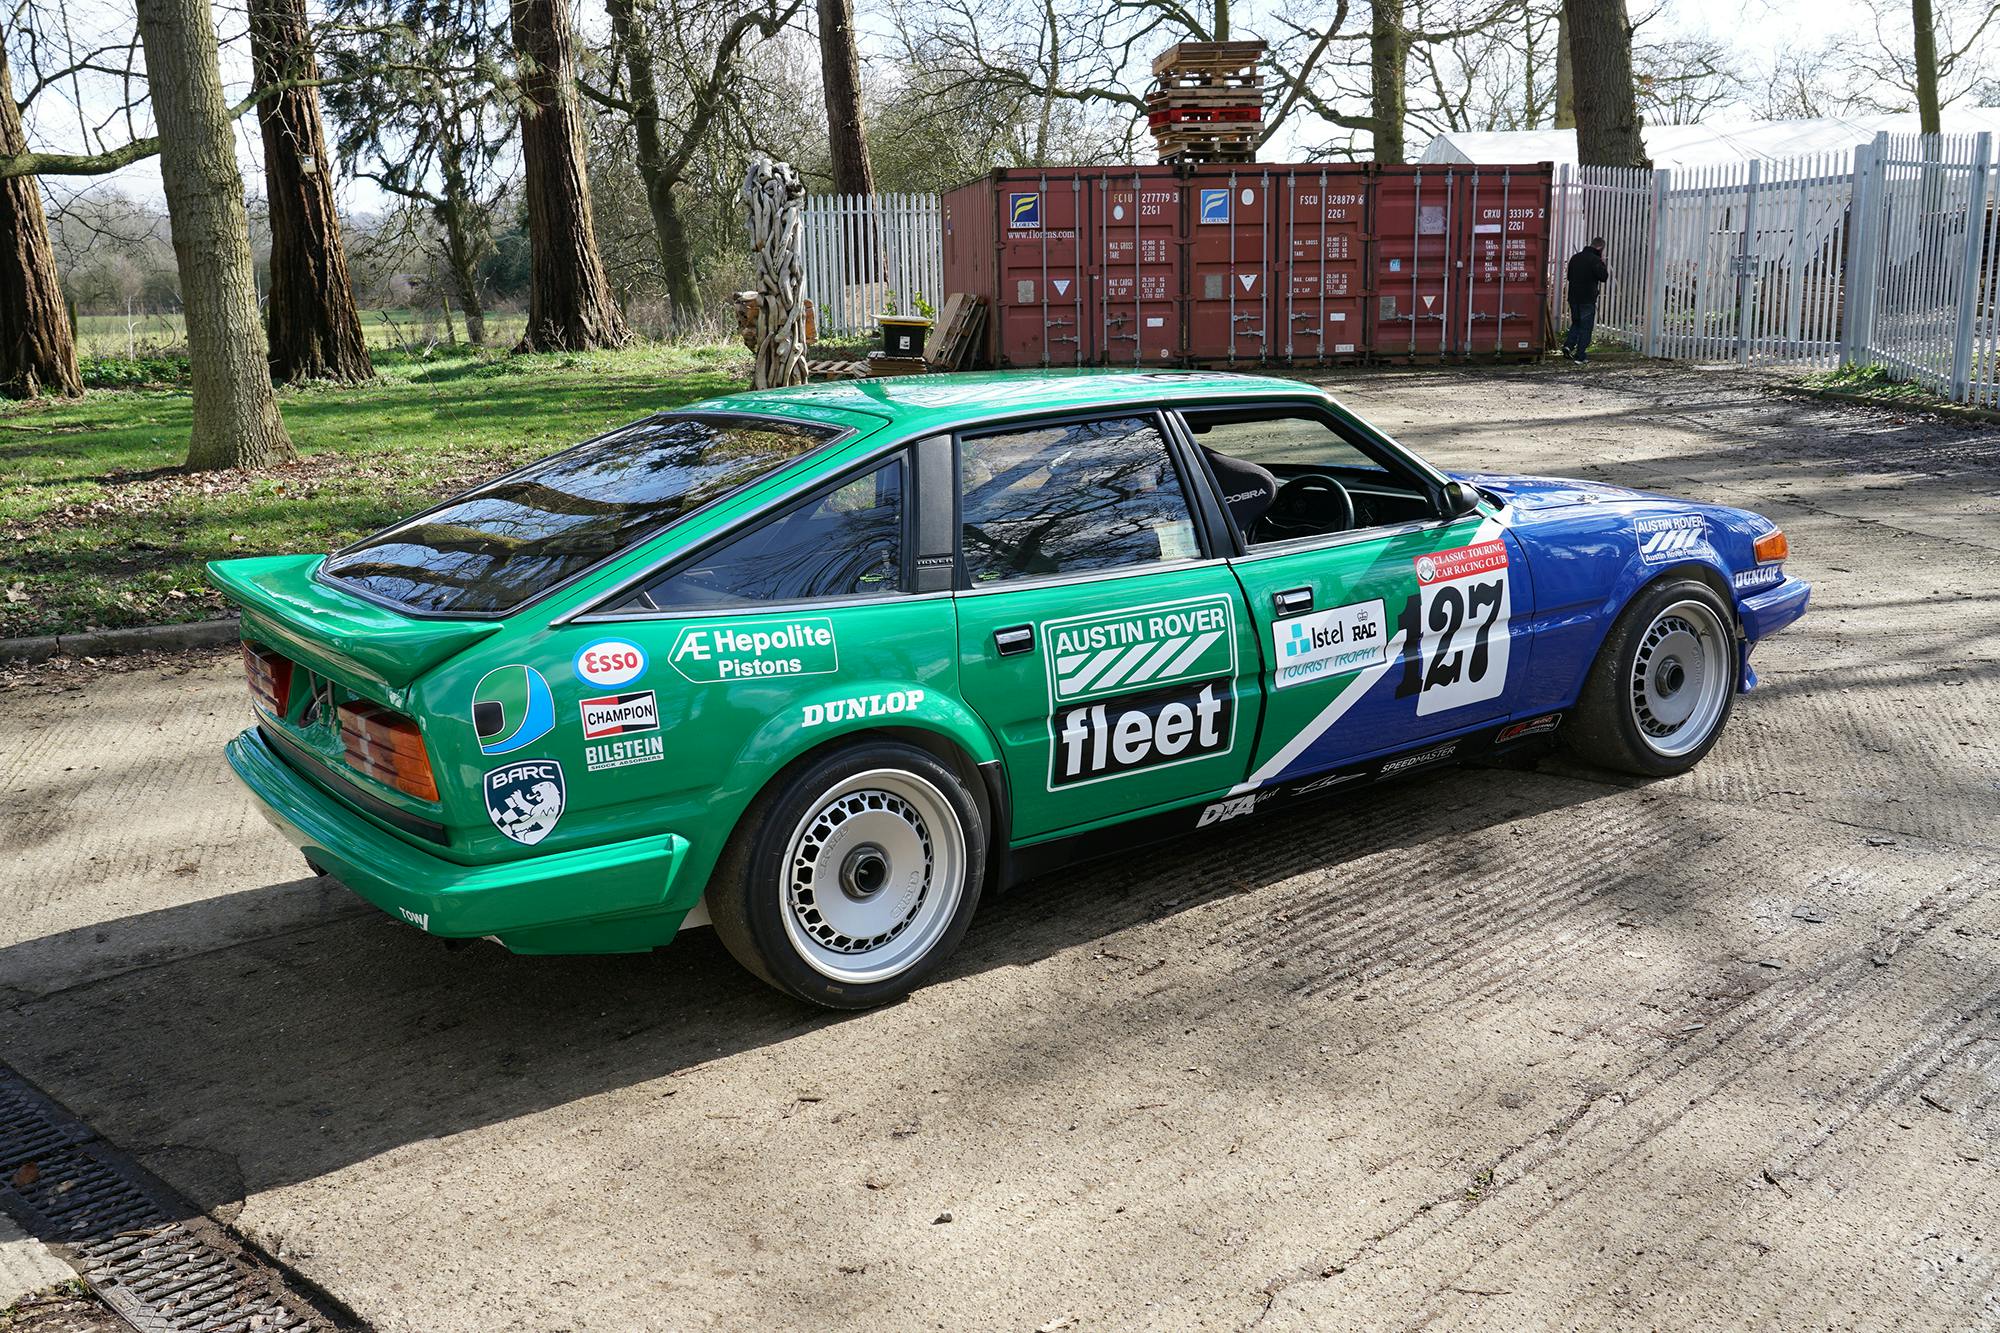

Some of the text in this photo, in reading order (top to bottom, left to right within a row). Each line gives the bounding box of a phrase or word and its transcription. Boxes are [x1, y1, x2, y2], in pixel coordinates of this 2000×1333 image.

[1141, 192, 1171, 203] 277779
[1299, 194, 1318, 205] FSCU
[1327, 194, 1356, 205] 328879
[1141, 205, 1161, 215] 22G1
[1483, 208, 1545, 219] CRXU 333195 2
[1508, 220, 1525, 231] 22G1
[1224, 488, 1267, 504] COBRA
[1638, 516, 1704, 533] AUSTIN ROVER
[1433, 542, 1504, 566] CLASSIC TOURING
[1436, 554, 1507, 579] CAR RACING CLUB
[713, 624, 832, 657] Hepolite
[1056, 607, 1226, 655] AUSTIN ROVER
[1311, 620, 1377, 650] Istel RAC
[718, 658, 802, 678] Pistons
[1282, 645, 1381, 680] TOURIST TROPHY
[587, 704, 654, 726] CHAMPION
[801, 689, 925, 728] DUNLOP
[1061, 683, 1222, 777] fleet
[585, 736, 664, 765] BILSTEIN
[590, 755, 662, 770] SHOCK ABSORBERS
[1380, 745, 1457, 773] SPEEDMASTER
[492, 765, 556, 790] BARC
[1195, 794, 1257, 829] DTA
[399, 906, 424, 925] TOW
